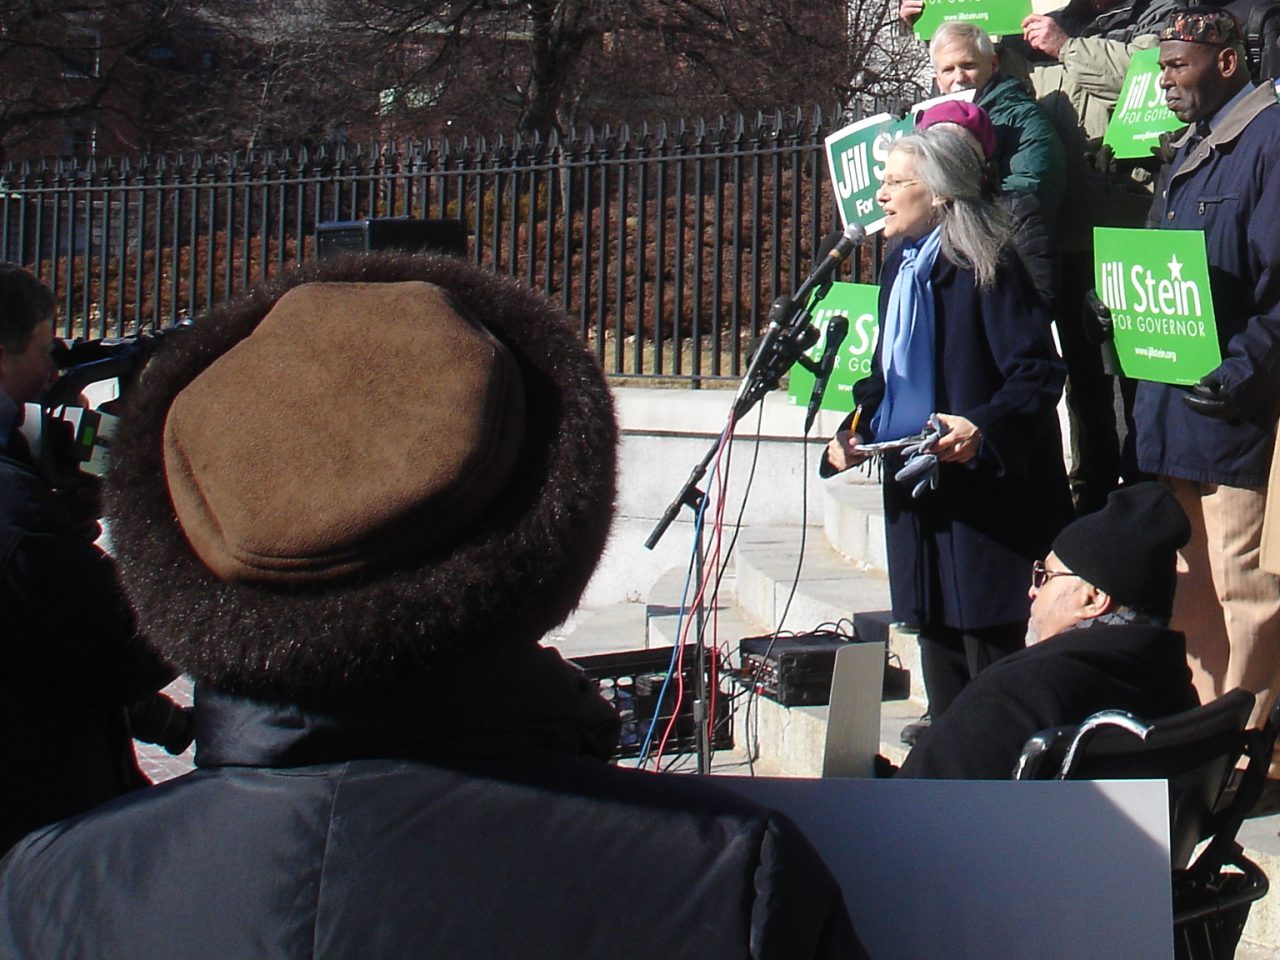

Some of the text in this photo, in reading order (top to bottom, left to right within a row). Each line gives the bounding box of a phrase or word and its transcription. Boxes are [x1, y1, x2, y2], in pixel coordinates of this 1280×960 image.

[1118, 72, 1152, 118] Jill
[838, 141, 870, 199] Jill
[855, 197, 874, 217] For
[1102, 253, 1202, 316] Jill Stein
[1112, 313, 1206, 337] FOR GOVERNOR
